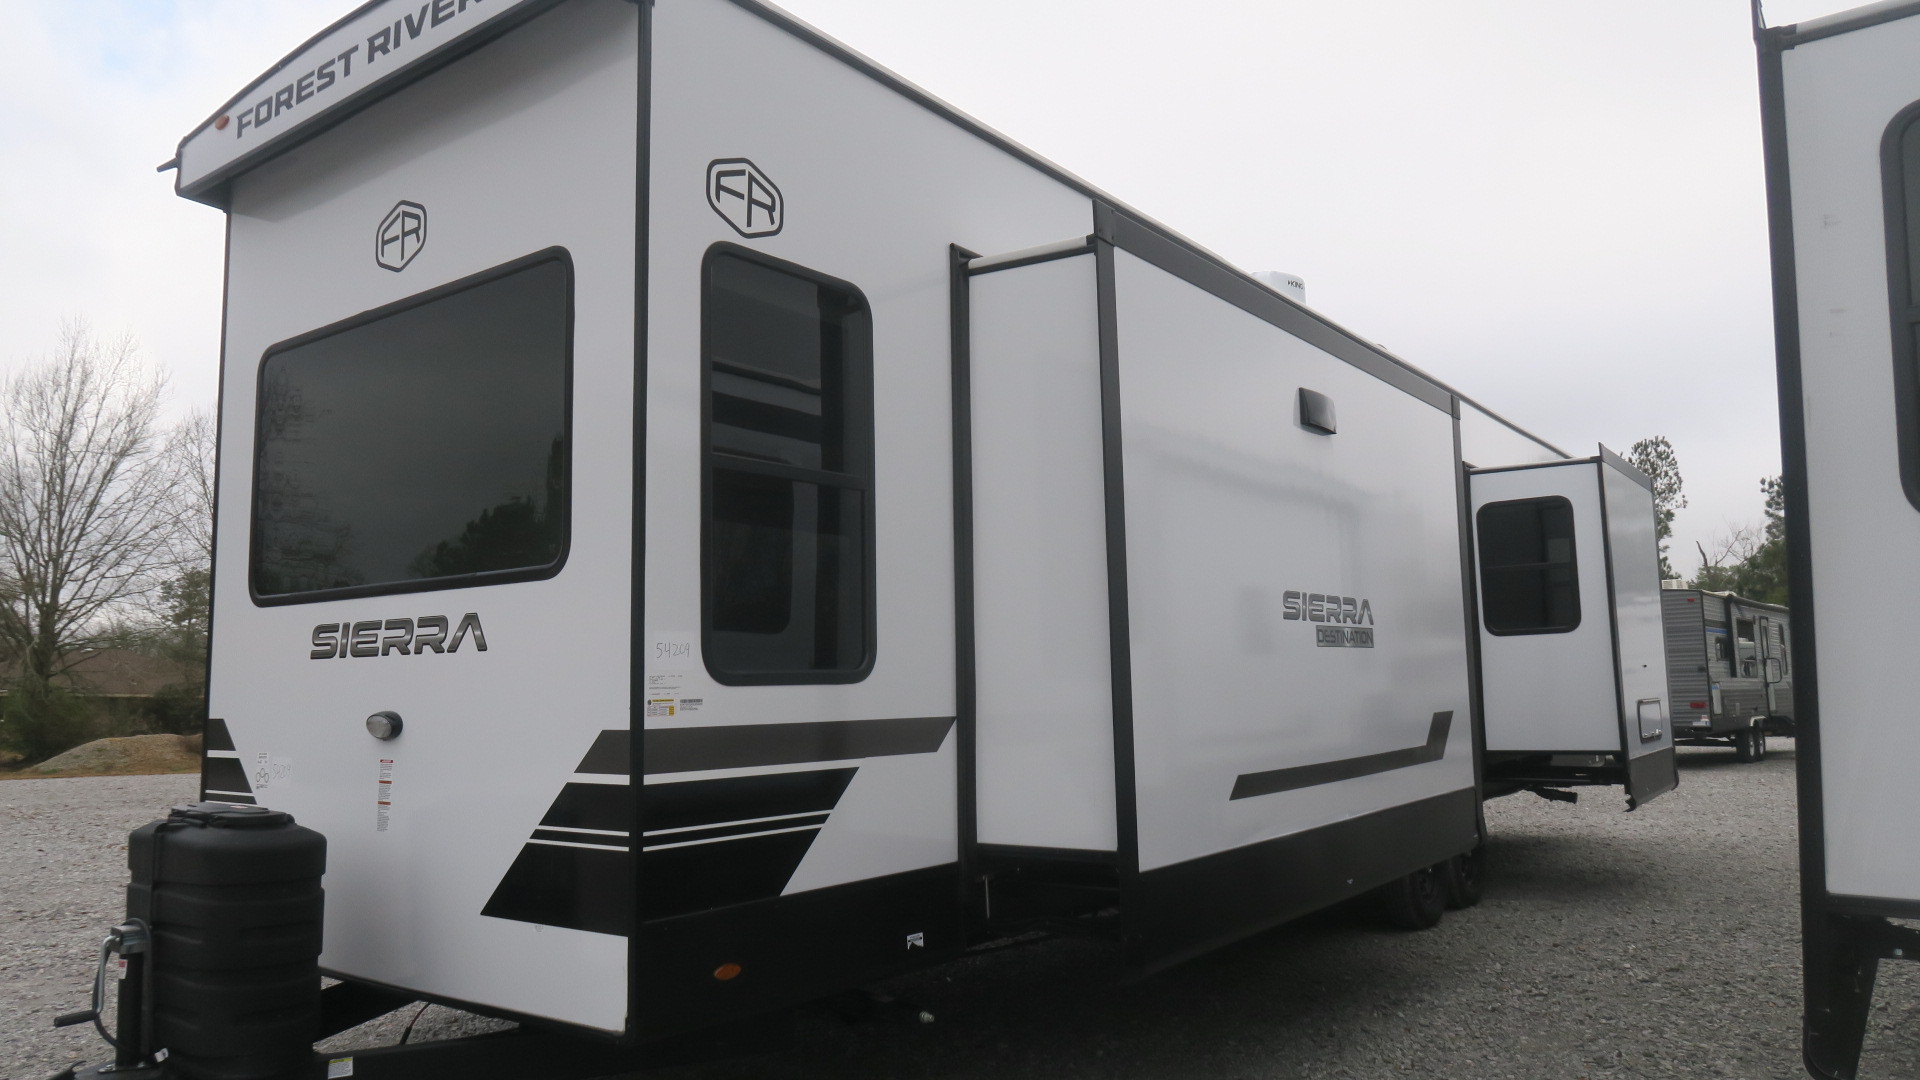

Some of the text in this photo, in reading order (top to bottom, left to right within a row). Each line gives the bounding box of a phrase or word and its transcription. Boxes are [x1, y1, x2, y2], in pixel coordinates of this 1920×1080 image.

[237, 44, 359, 139] FOREST
[1282, 590, 1374, 625] SIERRA
[310, 612, 488, 660] SIERRA
[656, 642, 690, 659] 54209
[1317, 629, 1373, 644] DESTINATION
